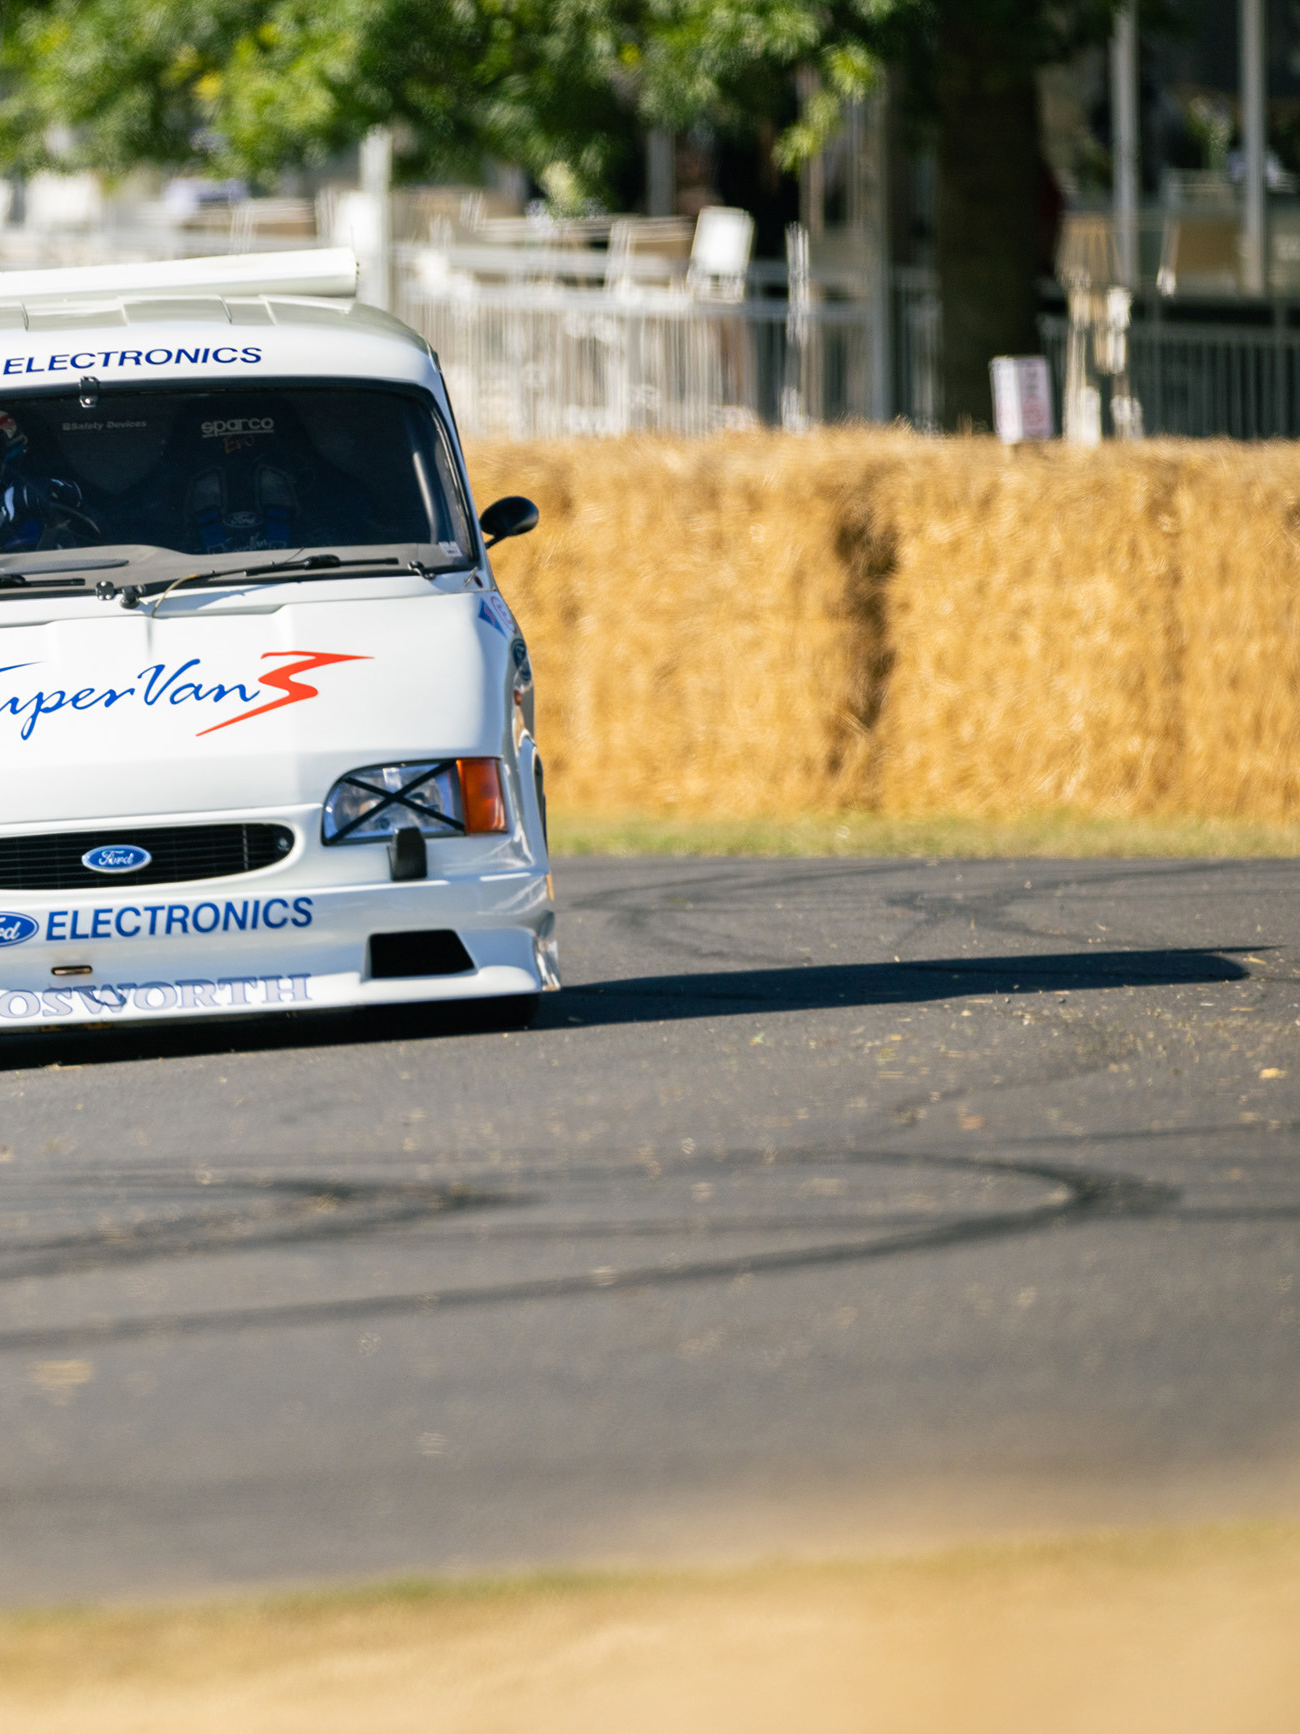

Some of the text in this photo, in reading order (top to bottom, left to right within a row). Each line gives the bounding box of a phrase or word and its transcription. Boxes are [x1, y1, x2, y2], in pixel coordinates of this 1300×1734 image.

[2, 347, 263, 376] ELECTRONICS
[71, 420, 148, 431] Safety Devices
[201, 417, 274, 437] sparco
[98, 846, 135, 866] Ford
[45, 896, 314, 942] ELECTRONICS
